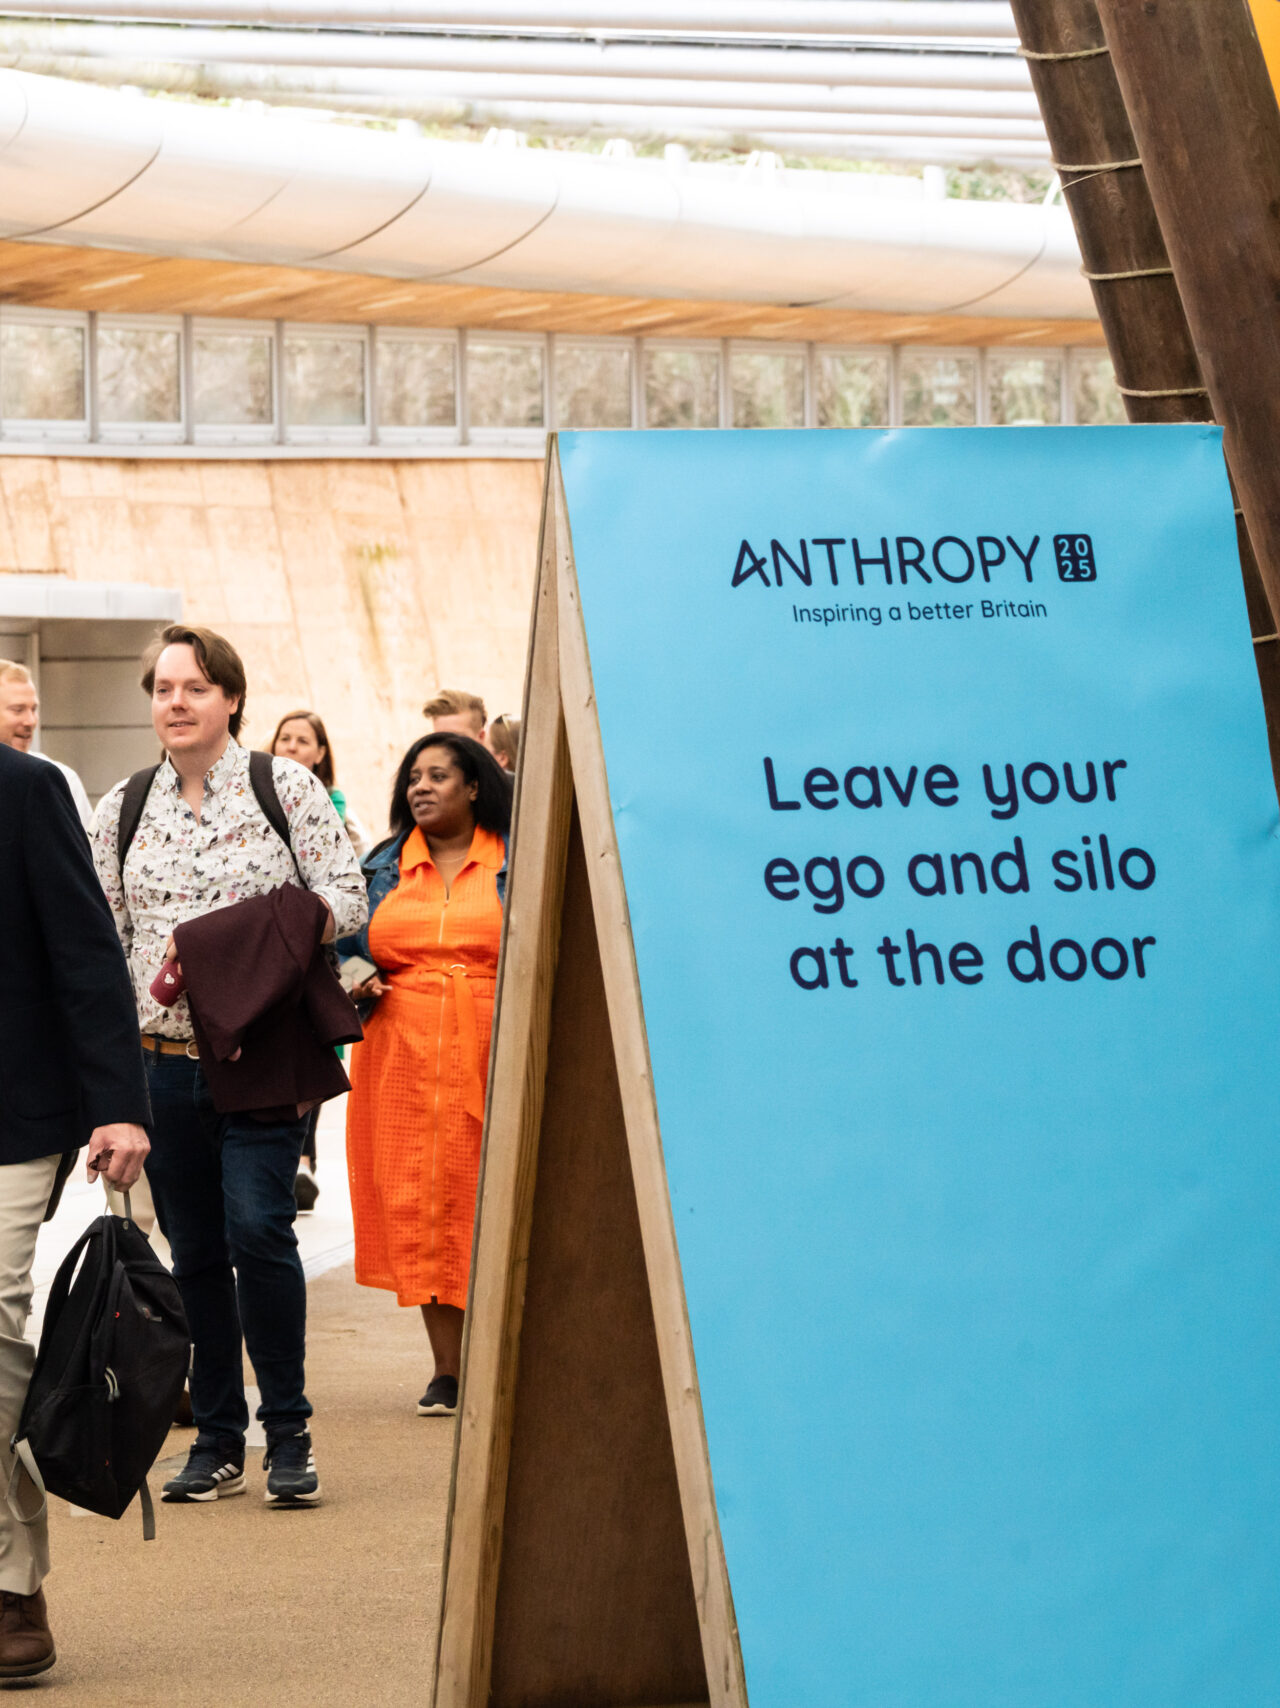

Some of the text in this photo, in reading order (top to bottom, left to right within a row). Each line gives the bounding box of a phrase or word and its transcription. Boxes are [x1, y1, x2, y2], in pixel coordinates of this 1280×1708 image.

[732, 534, 1041, 588] ANTHROPY
[793, 599, 1048, 627] Inspiring a better Britain
[763, 756, 1128, 821] Leave your
[763, 833, 1157, 915] ego and silo
[789, 924, 1157, 991] at the door
